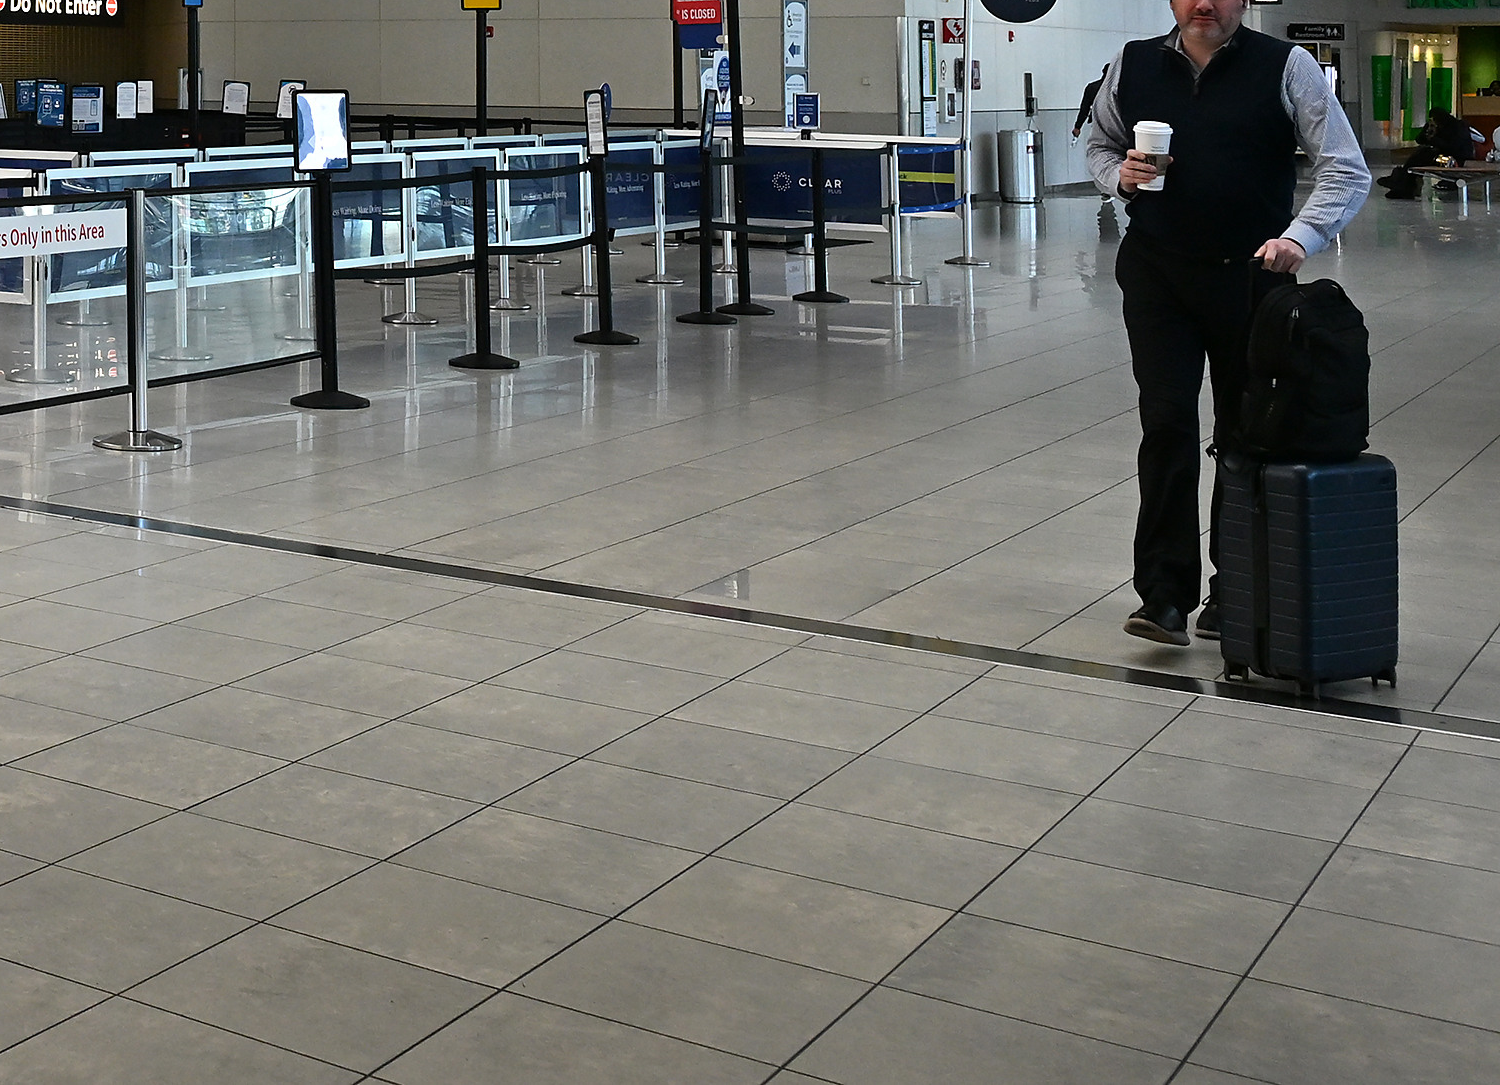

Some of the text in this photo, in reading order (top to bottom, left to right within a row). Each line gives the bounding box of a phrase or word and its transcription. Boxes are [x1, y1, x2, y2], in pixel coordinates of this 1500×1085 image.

[682, 8, 716, 19] IS CLOSED
[799, 178, 843, 189] CLAR
[10, 227, 38, 249] Only
[41, 226, 53, 243] in
[55, 223, 77, 243] this
[79, 223, 105, 241] Area
